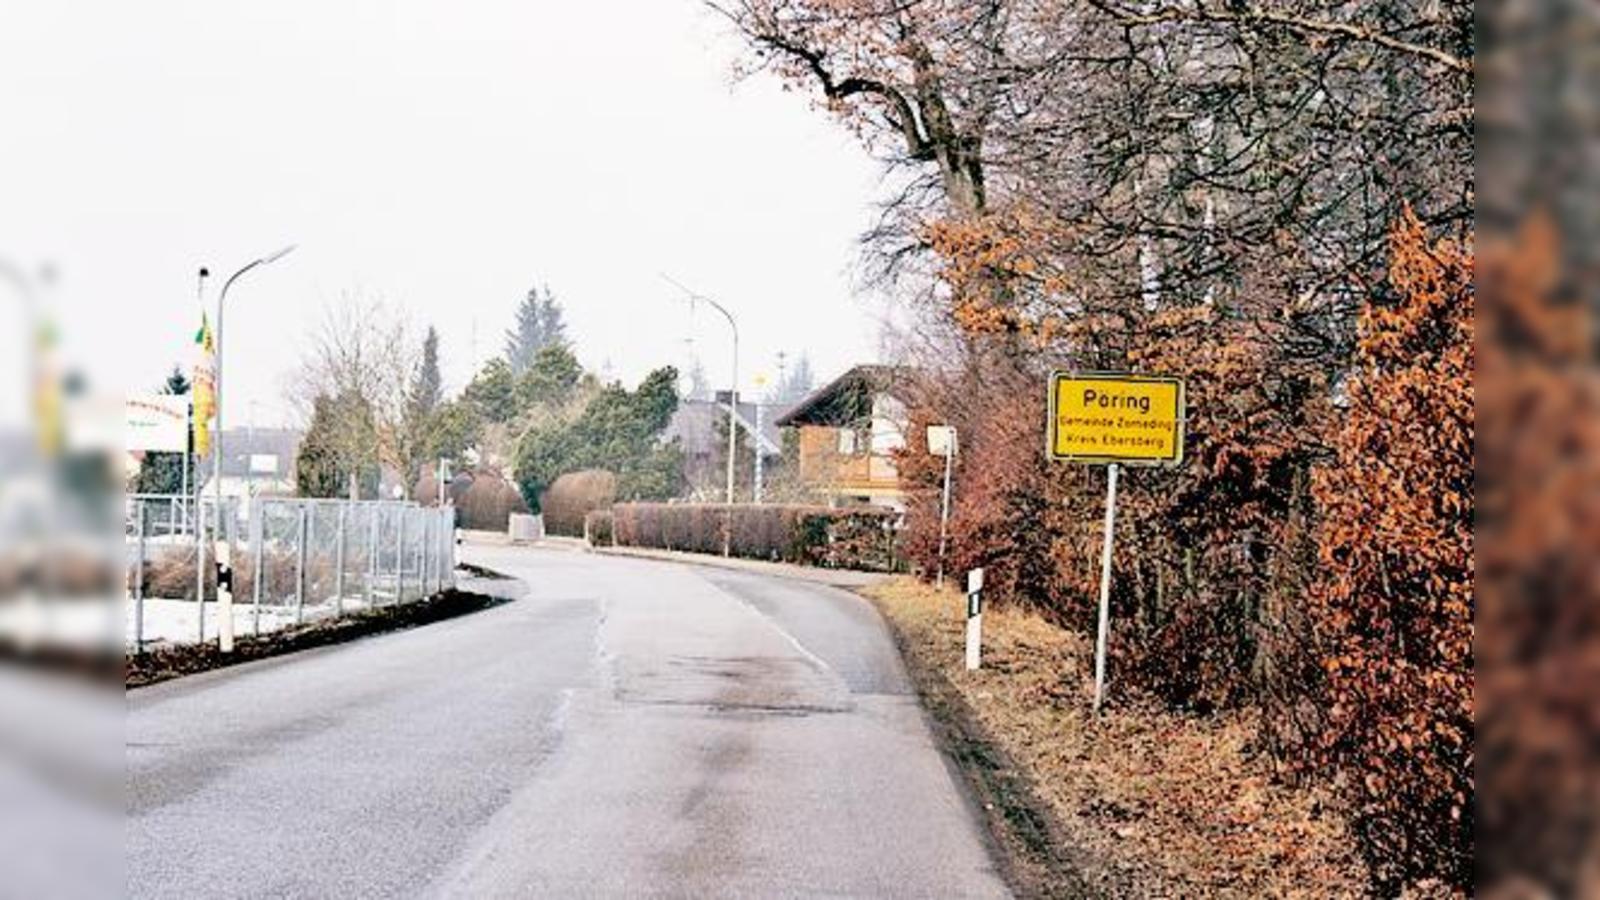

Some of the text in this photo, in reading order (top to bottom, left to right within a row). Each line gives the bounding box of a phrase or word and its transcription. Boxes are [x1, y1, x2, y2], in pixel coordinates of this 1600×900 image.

[1083, 388, 1150, 414] Pöring
[1060, 415, 1114, 427] Gemeinde
[1066, 434, 1165, 449] Kreis Ebersberg
